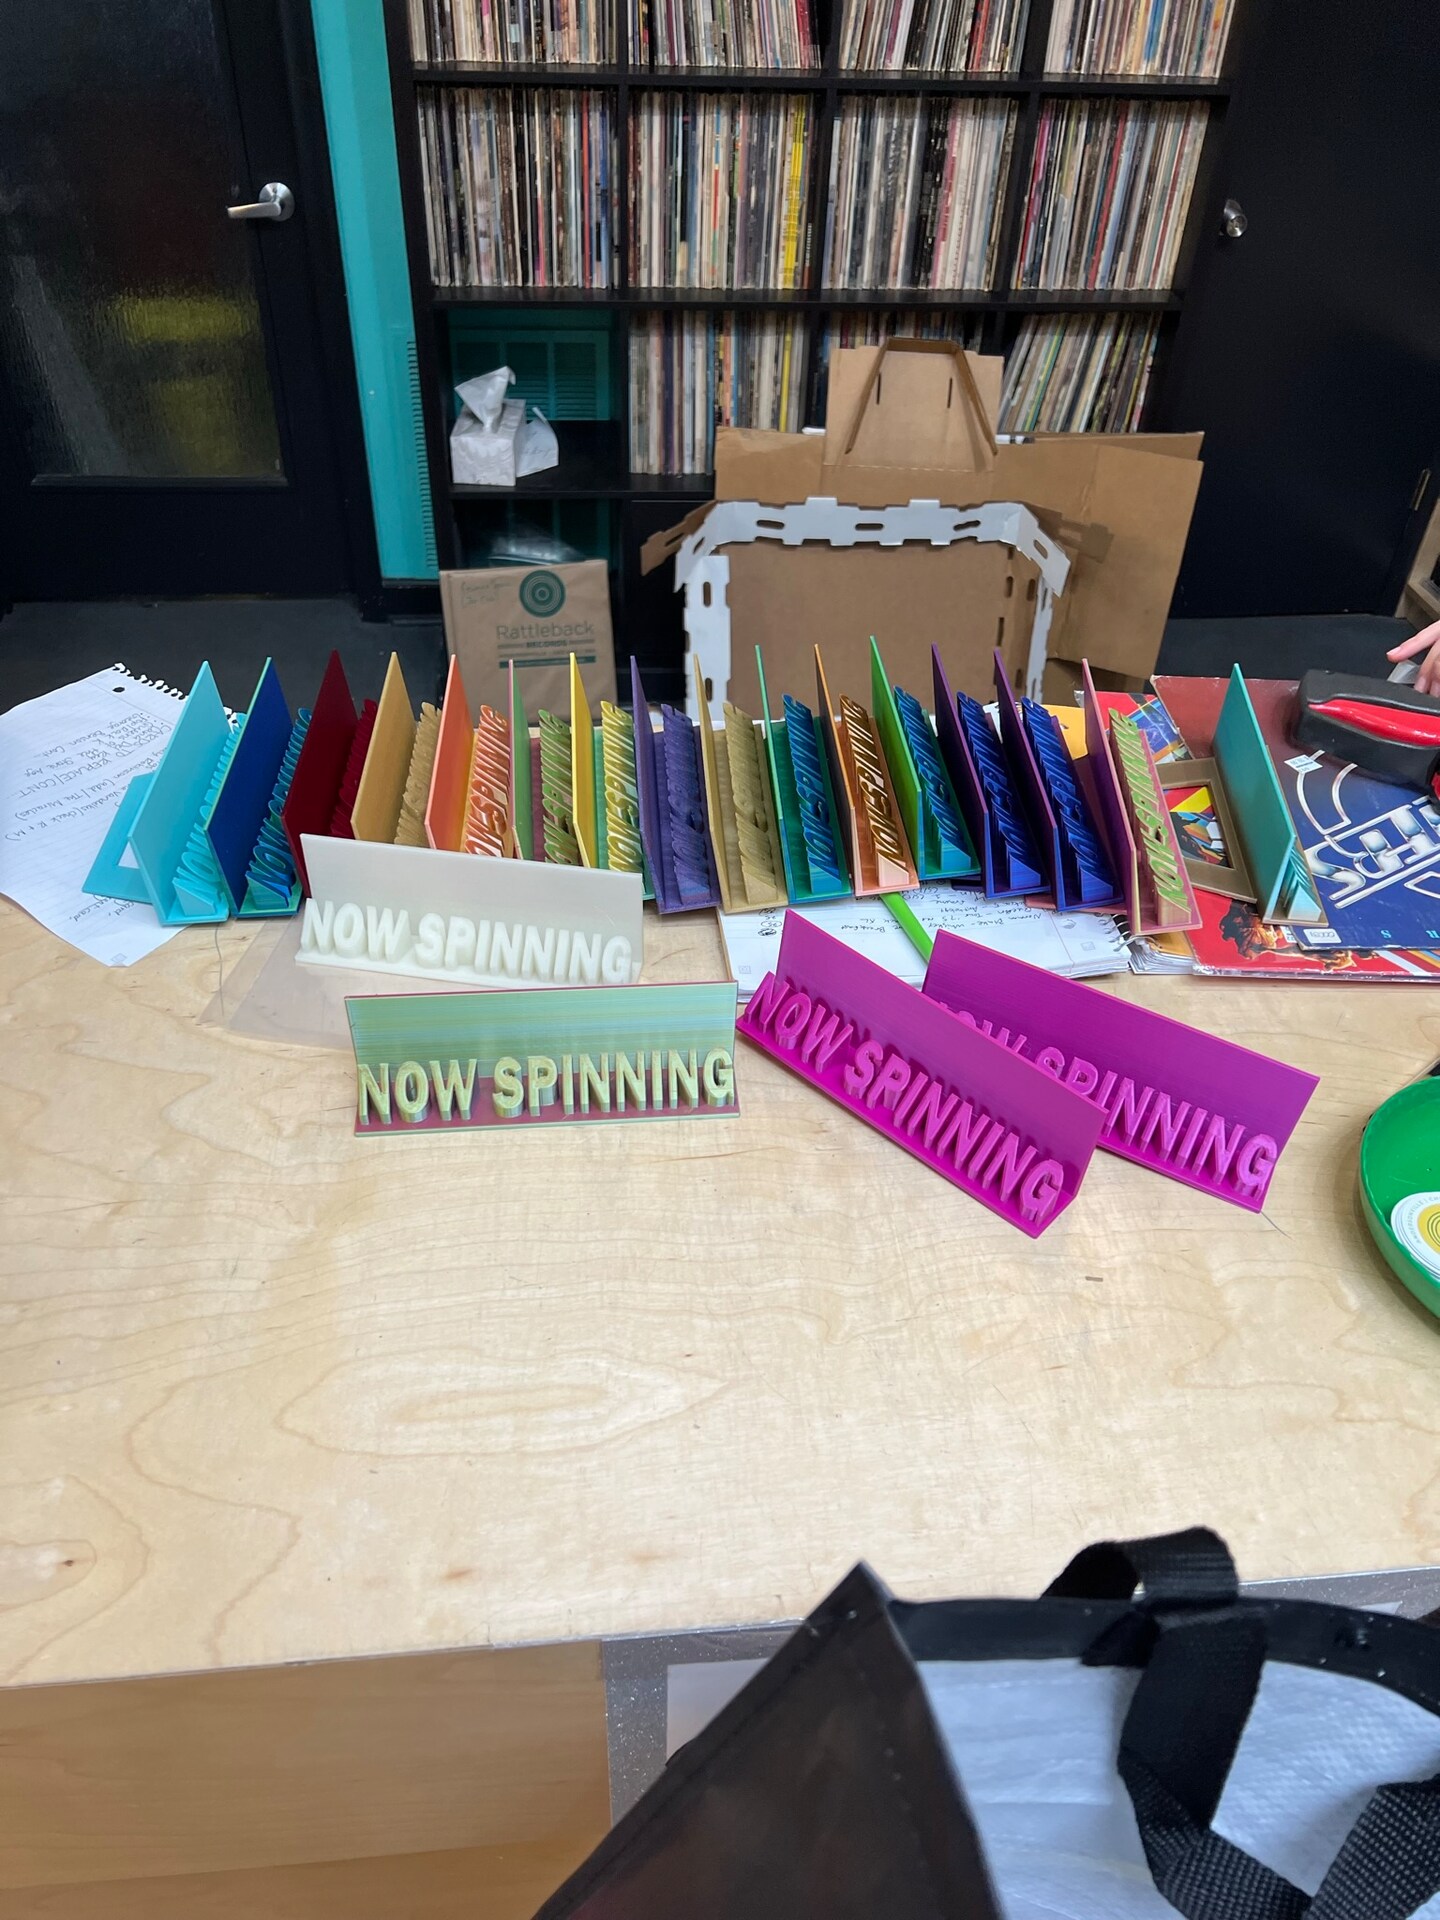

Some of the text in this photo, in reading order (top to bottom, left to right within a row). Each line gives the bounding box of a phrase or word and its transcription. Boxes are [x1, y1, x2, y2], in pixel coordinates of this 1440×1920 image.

[496, 620, 595, 640] Rattleback
[1108, 707, 1192, 913] NOW SPINNING
[301, 897, 633, 984] NOW SPINNING
[358, 1047, 735, 1125] NOW SPINNING
[744, 972, 1065, 1224] NOW SPINNING
[1034, 1047, 1279, 1197] SPINNING
